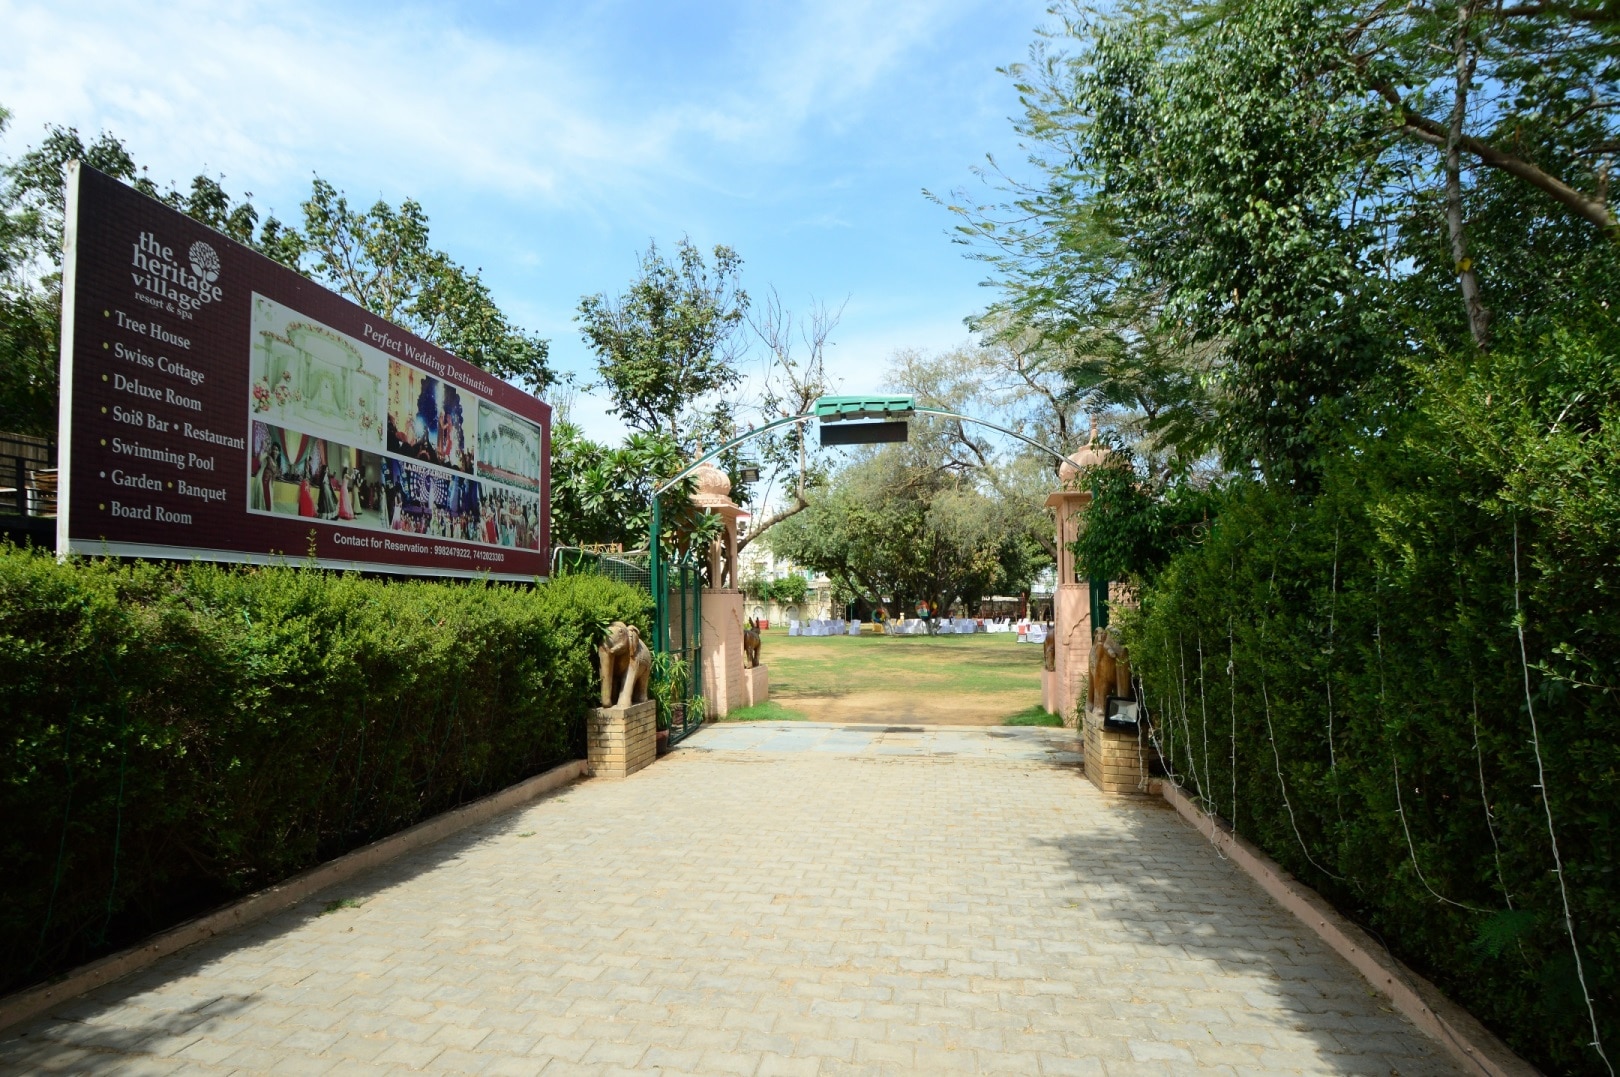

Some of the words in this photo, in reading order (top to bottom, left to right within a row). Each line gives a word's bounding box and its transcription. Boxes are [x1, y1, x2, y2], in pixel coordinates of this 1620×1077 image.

[139, 231, 174, 262] the
[131, 272, 201, 310] village
[132, 243, 222, 304] heritage
[134, 291, 164, 309] resort
[165, 302, 175, 313] &
[177, 308, 193, 320] spa
[115, 309, 147, 335] Tree
[150, 322, 191, 350] House
[114, 342, 155, 368] Swiss
[158, 356, 205, 386] Cottage
[363, 323, 402, 352] Perfect
[404, 343, 446, 376] Wedding
[447, 364, 494, 397] Destination
[113, 373, 163, 401] Deluxe
[166, 388, 202, 412] Room
[113, 405, 144, 427] Soi8
[147, 413, 169, 433] Bar
[183, 422, 245, 450] Restaurant
[112, 437, 186, 470] Swimming
[188, 452, 215, 471] Pool
[111, 469, 163, 491] Garden
[177, 479, 227, 502] Banquet
[111, 500, 151, 520] Board
[155, 506, 192, 525] Room
[333, 532, 369, 547] Contact
[370, 537, 383, 549] for
[384, 539, 429, 554] Reservation
